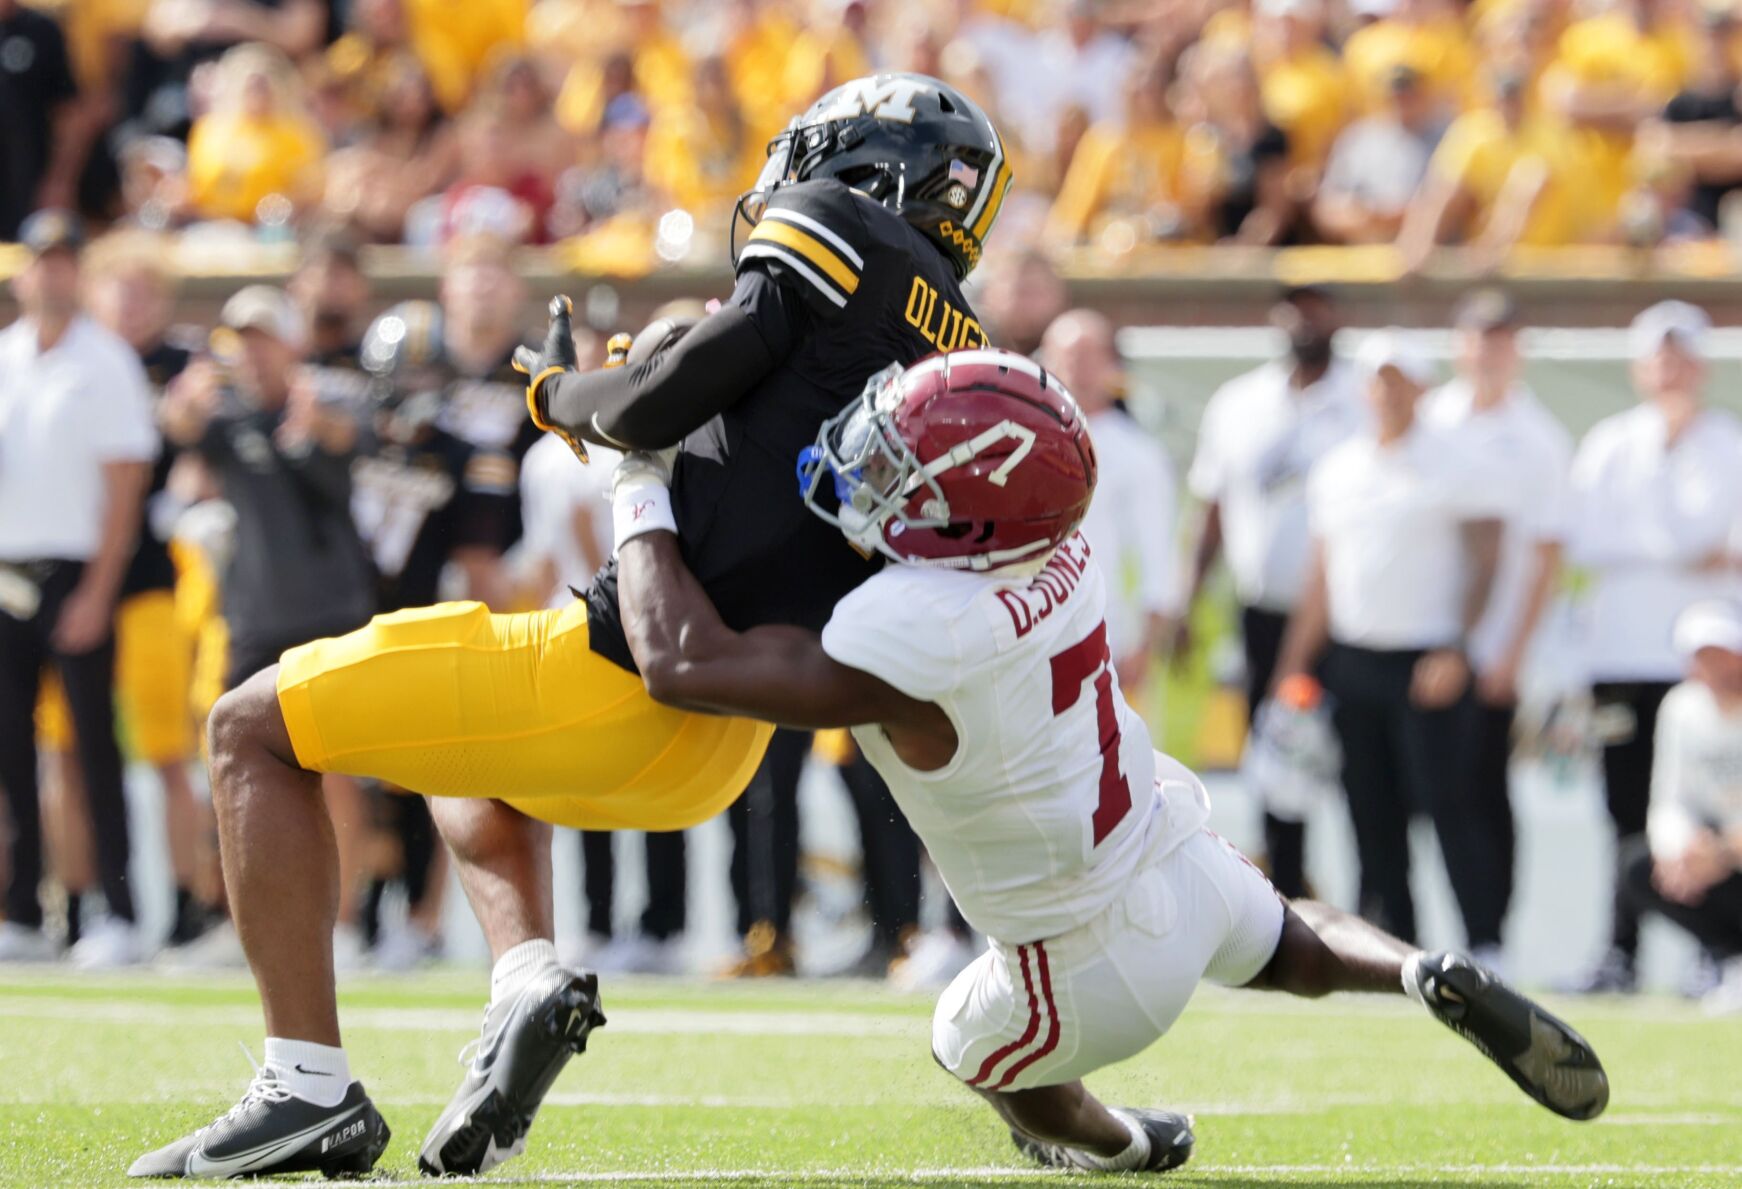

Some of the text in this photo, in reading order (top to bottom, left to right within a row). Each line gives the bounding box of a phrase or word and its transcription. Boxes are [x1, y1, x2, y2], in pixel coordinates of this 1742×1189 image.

[827, 77, 929, 124] M
[1049, 617, 1132, 849] 7
[321, 1119, 366, 1154] VAPOR
